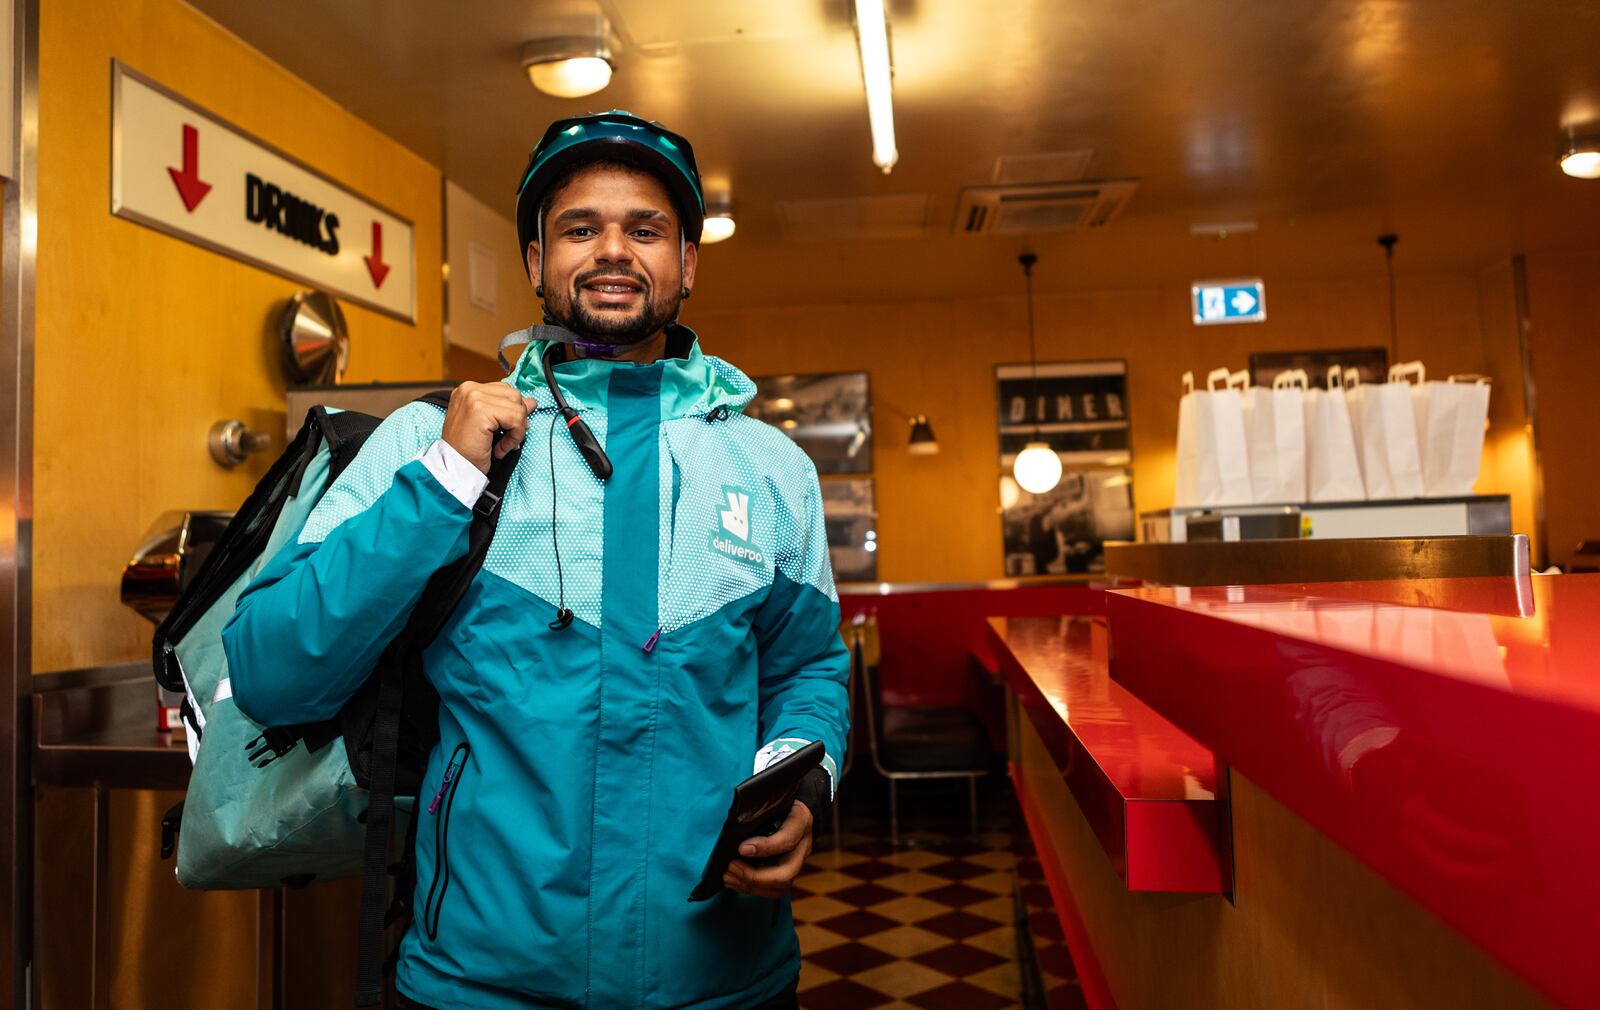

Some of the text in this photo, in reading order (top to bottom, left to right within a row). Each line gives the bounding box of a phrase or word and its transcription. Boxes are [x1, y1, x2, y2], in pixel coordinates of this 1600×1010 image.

[245, 172, 340, 256] DRINKS
[1010, 393, 1124, 421] DINER
[712, 535, 763, 563] deliveroo
